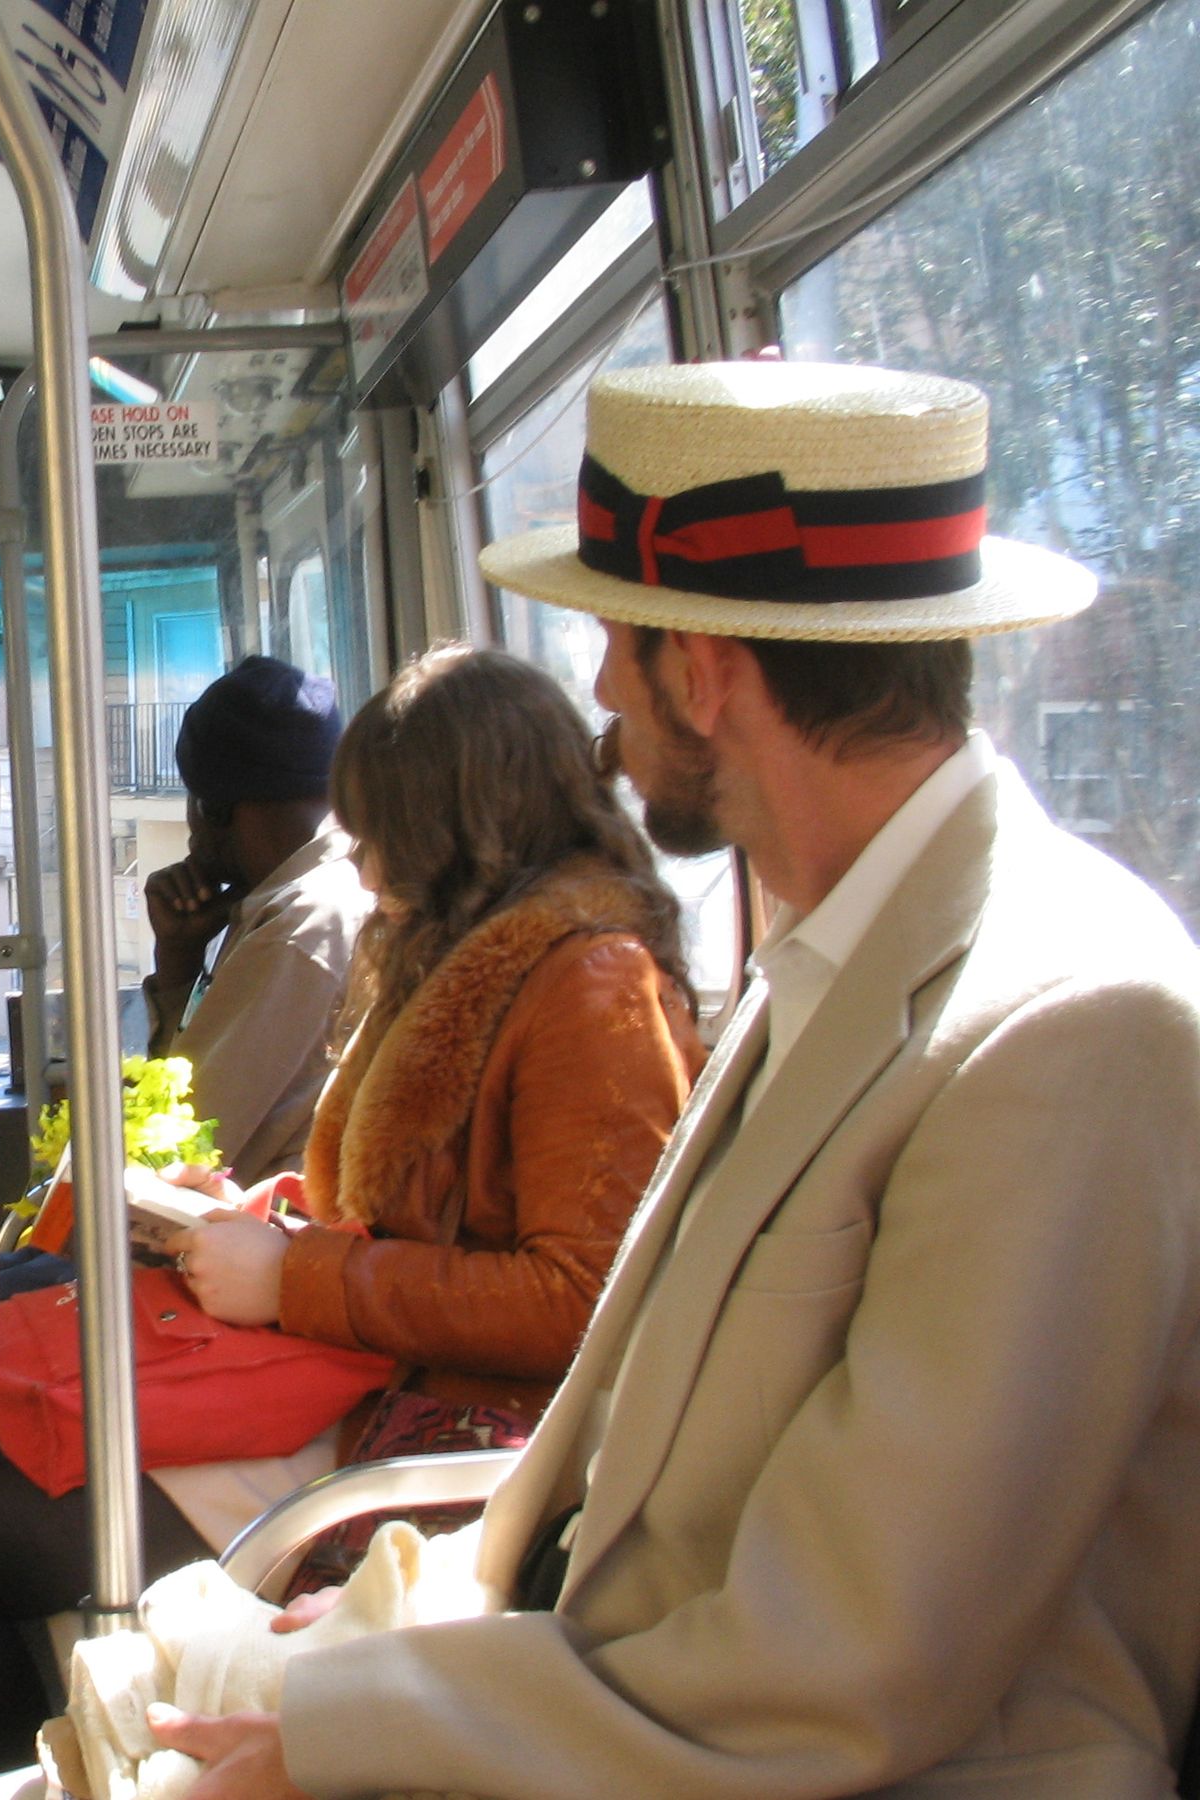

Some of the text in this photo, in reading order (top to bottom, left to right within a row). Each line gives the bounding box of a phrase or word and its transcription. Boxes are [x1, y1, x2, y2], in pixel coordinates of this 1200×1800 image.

[90, 406, 189, 423] ASE HOLD ON
[123, 424, 164, 440] STOPS
[171, 423, 198, 438] ARE
[135, 441, 212, 458] NECESSARY
